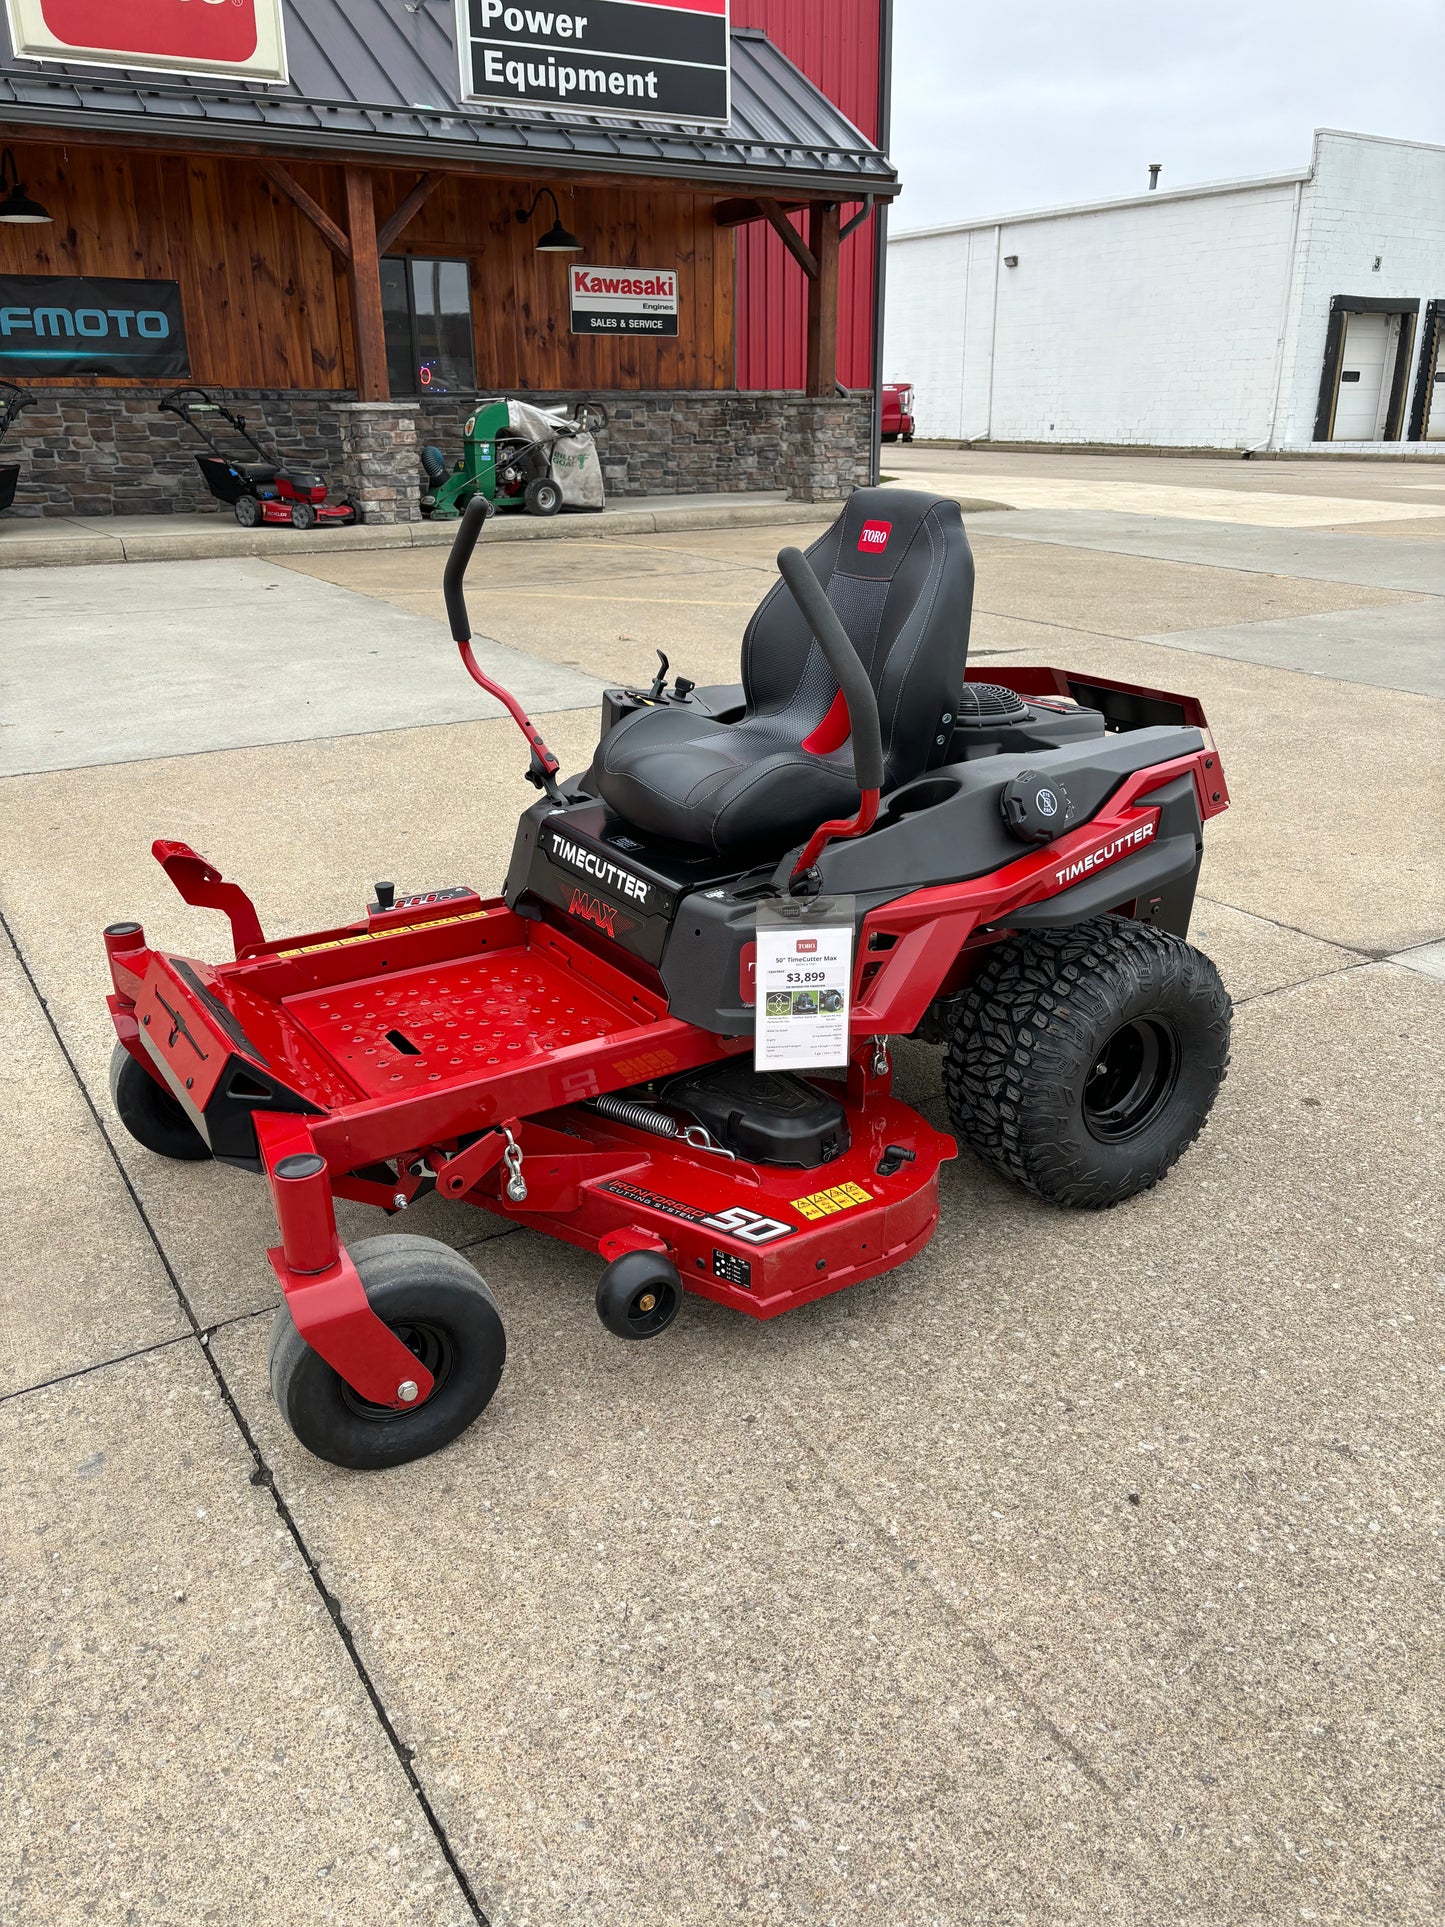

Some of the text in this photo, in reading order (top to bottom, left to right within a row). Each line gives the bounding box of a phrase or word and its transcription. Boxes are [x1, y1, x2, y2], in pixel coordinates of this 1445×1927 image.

[481, 0, 588, 39] Power
[484, 50, 658, 98] Equipment
[1374, 257, 1381, 269] 3
[574, 271, 674, 296] Kawasaki
[590, 318, 664, 329] SALES & SERVICE
[642, 303, 674, 311] Engines
[554, 451, 577, 462] BILLY
[862, 529, 887, 544] TORO
[552, 834, 646, 904] TIMECUTTER
[1056, 822, 1154, 885] TIMECUTTER
[568, 888, 618, 939] MAX
[787, 972, 826, 984] $3,899
[609, 1180, 706, 1217] IRONFORGED
[609, 1186, 695, 1221] CUTTING SYSTEM
[700, 1206, 792, 1242] 50
